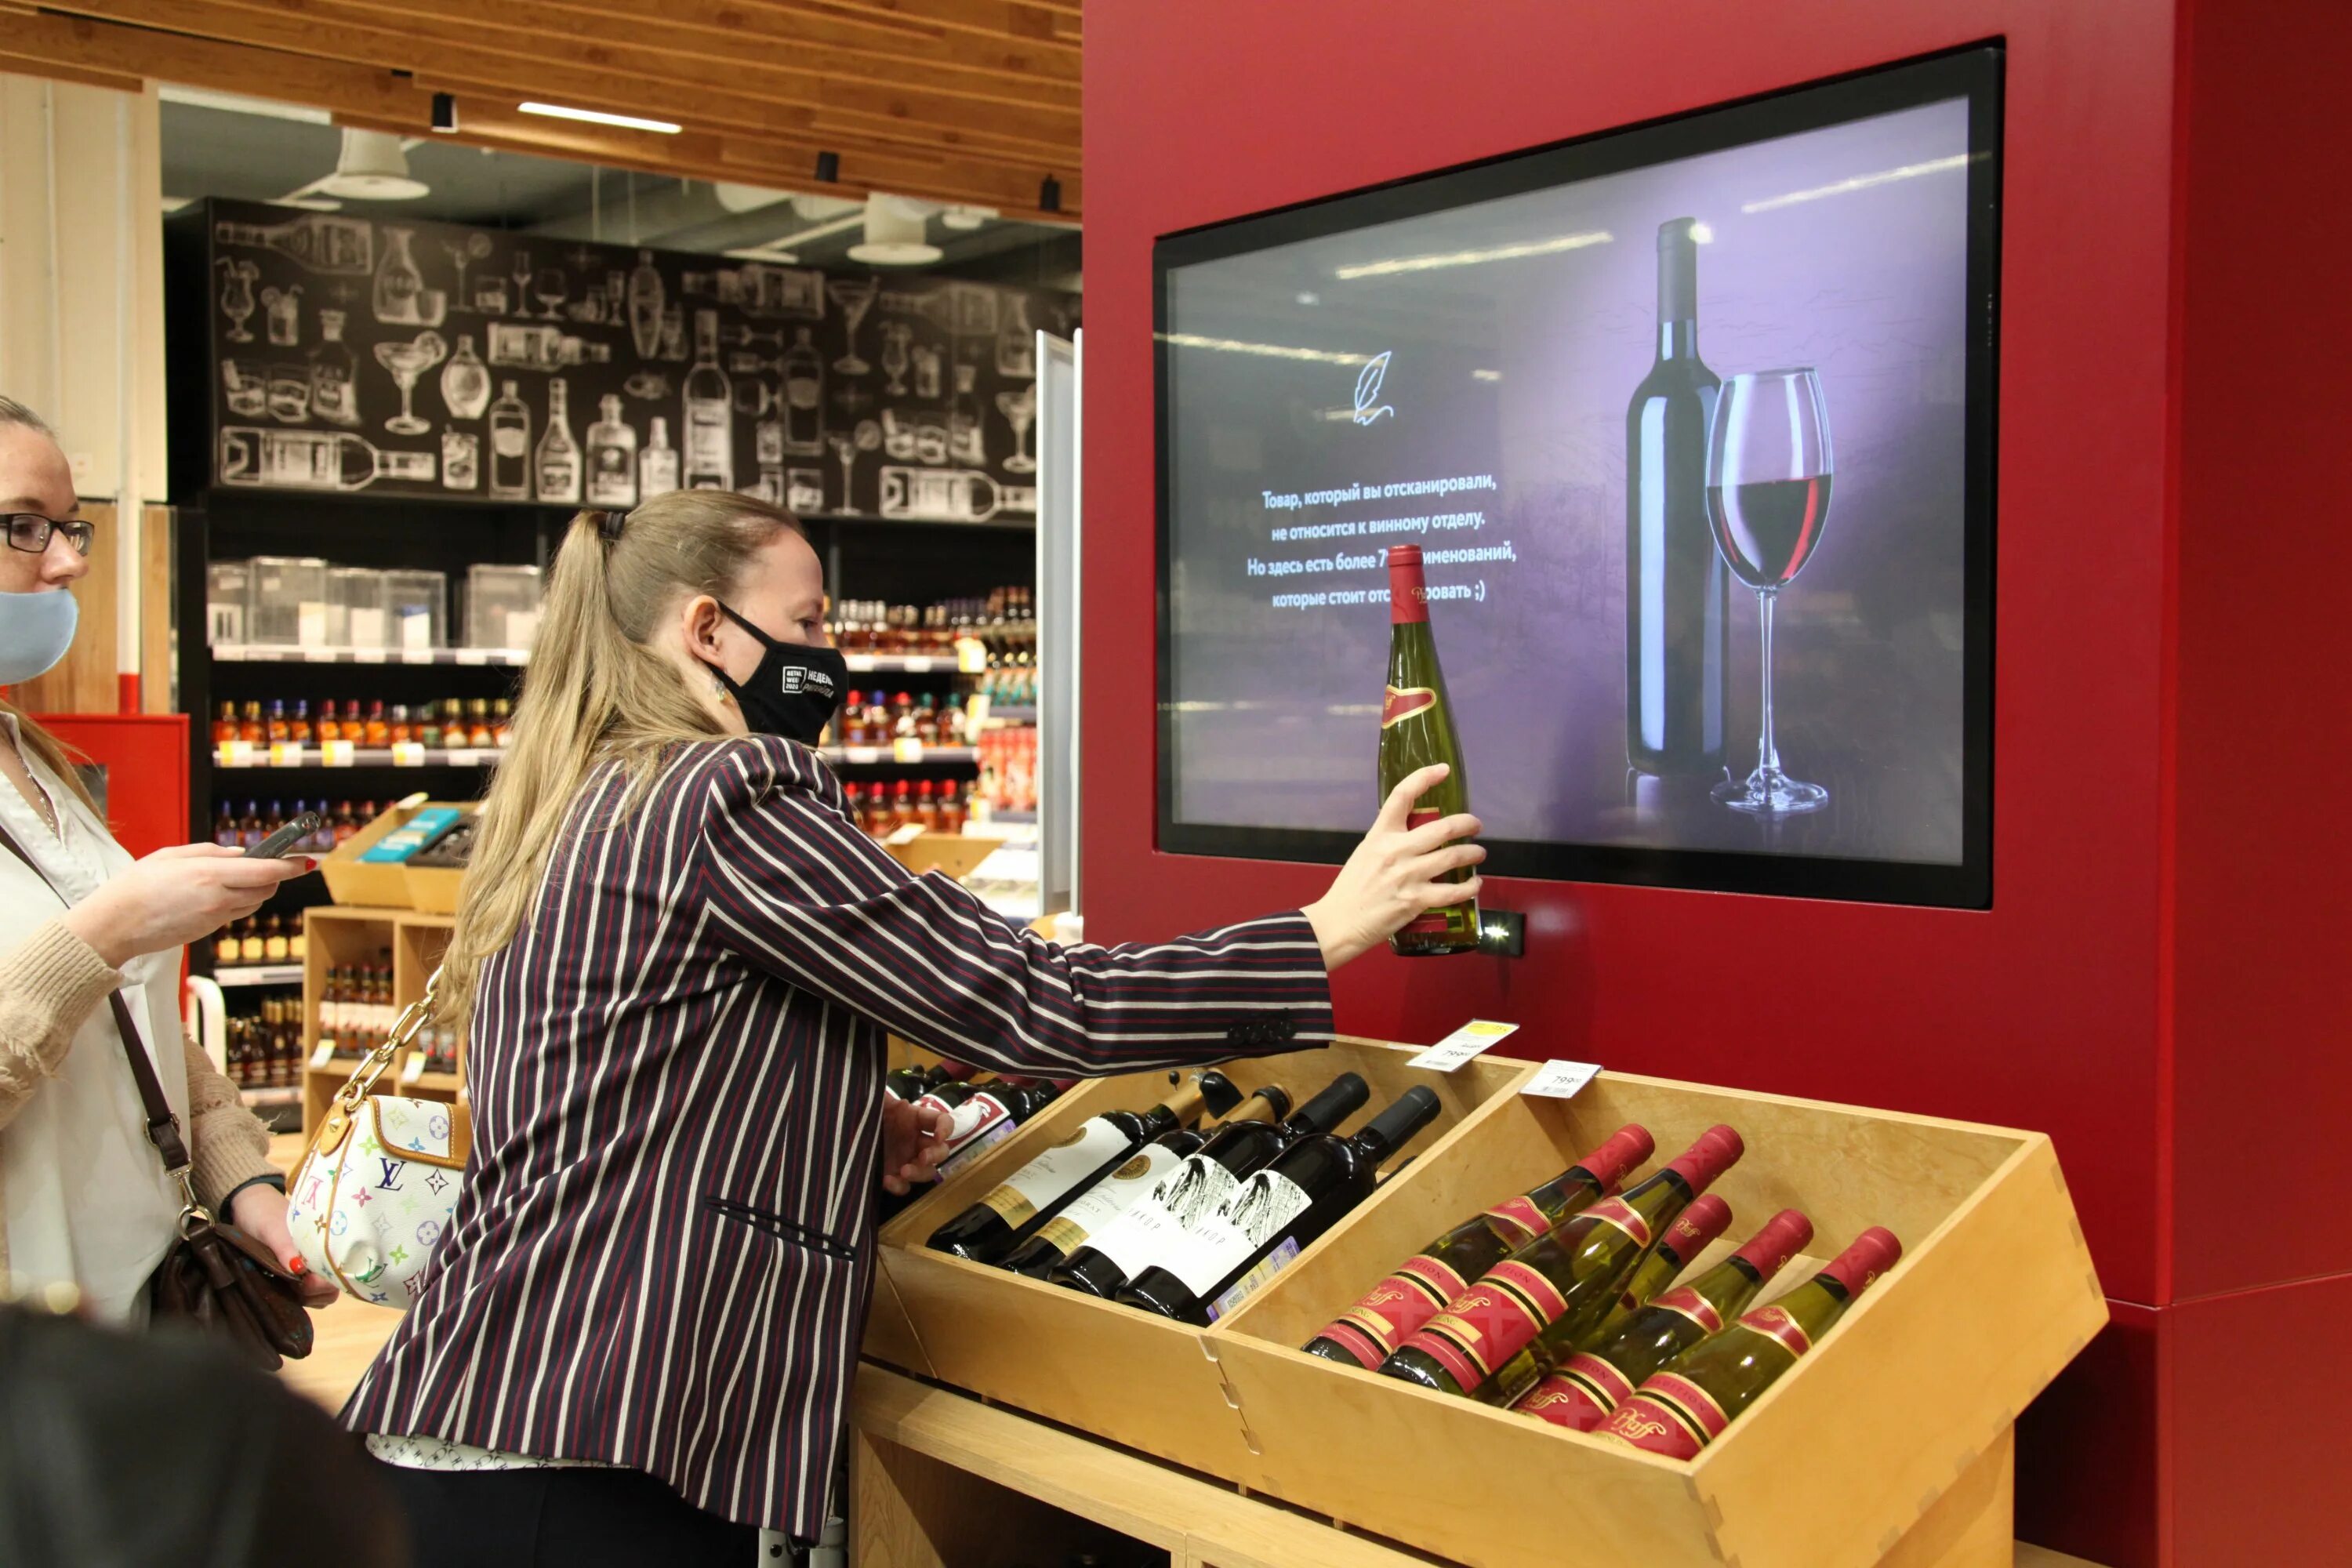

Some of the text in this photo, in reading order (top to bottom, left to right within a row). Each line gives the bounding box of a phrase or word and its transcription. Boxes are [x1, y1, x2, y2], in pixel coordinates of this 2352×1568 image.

[1262, 474, 1497, 510] Товар, который вы отсканировали,
[1272, 511, 1486, 541] не относится к винному отделу.
[1247, 558, 1266, 576] Но
[1268, 560, 1303, 577] здесь
[1305, 558, 1334, 572] есть
[1336, 552, 1376, 571] более
[1423, 540, 1517, 564] именований,
[1272, 592, 1327, 611] которые
[1329, 590, 1366, 604] стоит
